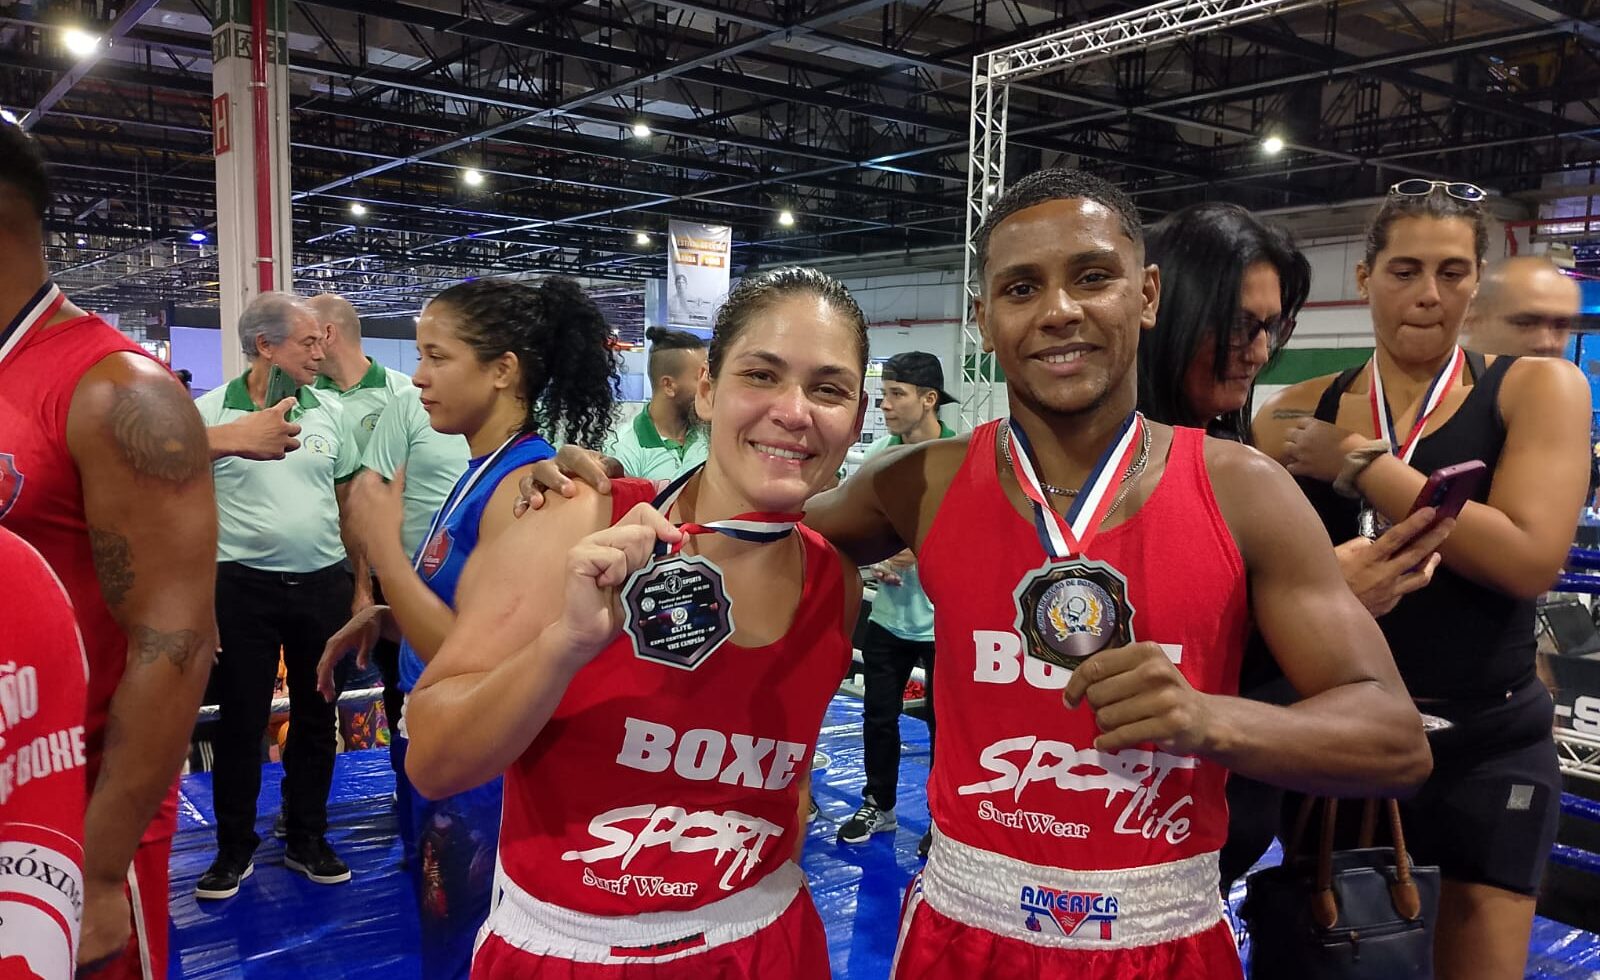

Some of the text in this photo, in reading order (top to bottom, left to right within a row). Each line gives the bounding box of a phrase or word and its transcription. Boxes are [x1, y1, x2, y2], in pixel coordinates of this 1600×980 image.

[215, 100, 228, 150] H
[650, 638, 665, 646] EXPO
[665, 633, 687, 642] CENTER
[671, 623, 693, 634] ELITE
[17, 725, 86, 786] BOXE
[616, 717, 807, 790] BOXE
[958, 736, 1199, 820] SPORT
[978, 800, 1090, 839] Surf Wear
[1114, 786, 1193, 844] Life
[561, 804, 784, 881] SPORT
[583, 867, 698, 897] Surf Wear
